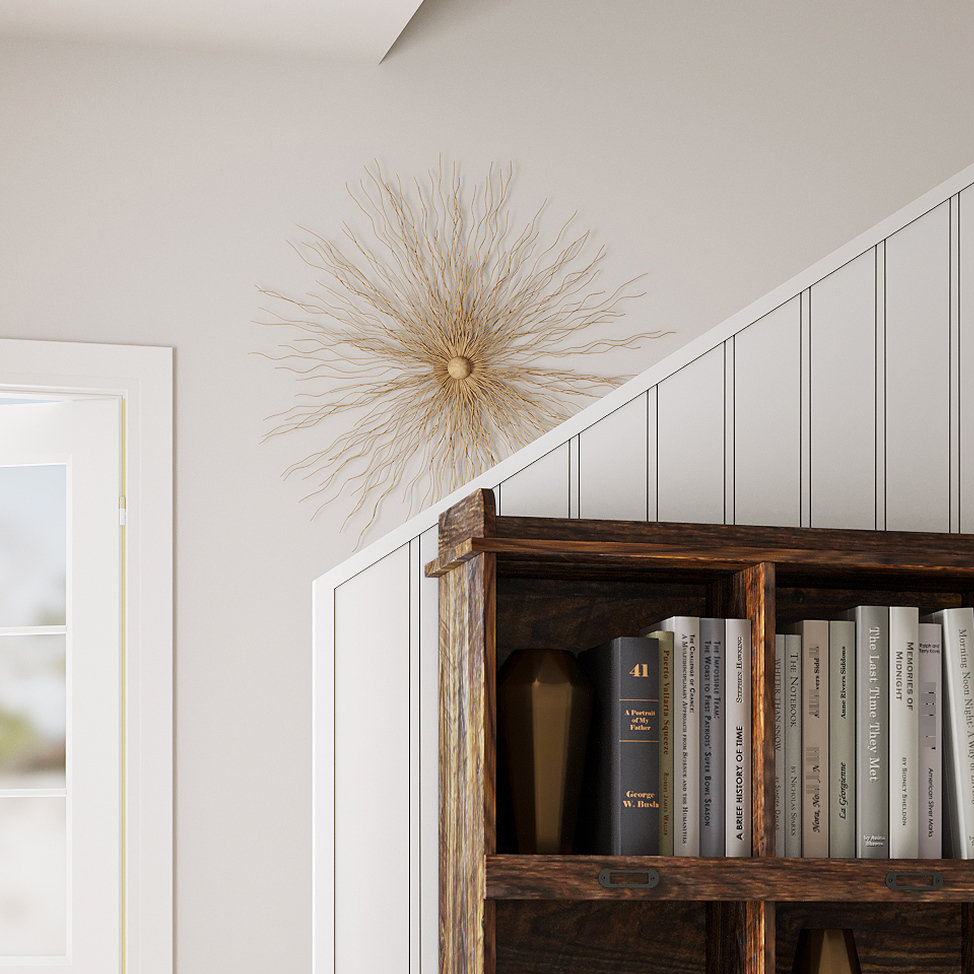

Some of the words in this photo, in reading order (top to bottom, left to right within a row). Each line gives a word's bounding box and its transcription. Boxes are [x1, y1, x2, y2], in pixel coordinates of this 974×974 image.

[868, 626, 881, 651] The
[958, 628, 969, 669] Morning
[628, 663, 649, 678] 41
[662, 649, 670, 679] Puerto
[868, 654, 881, 682] Last
[961, 671, 972, 696] Noon
[868, 686, 881, 718] Time
[662, 718, 670, 755] Squeeze
[735, 725, 743, 747] TIME
[867, 722, 881, 753] They
[735, 749, 743, 762] OF
[868, 757, 881, 781] Met
[626, 790, 655, 799] George
[735, 765, 743, 801] HISTORY
[735, 803, 743, 830] BRIEF
[735, 833, 743, 841] A
